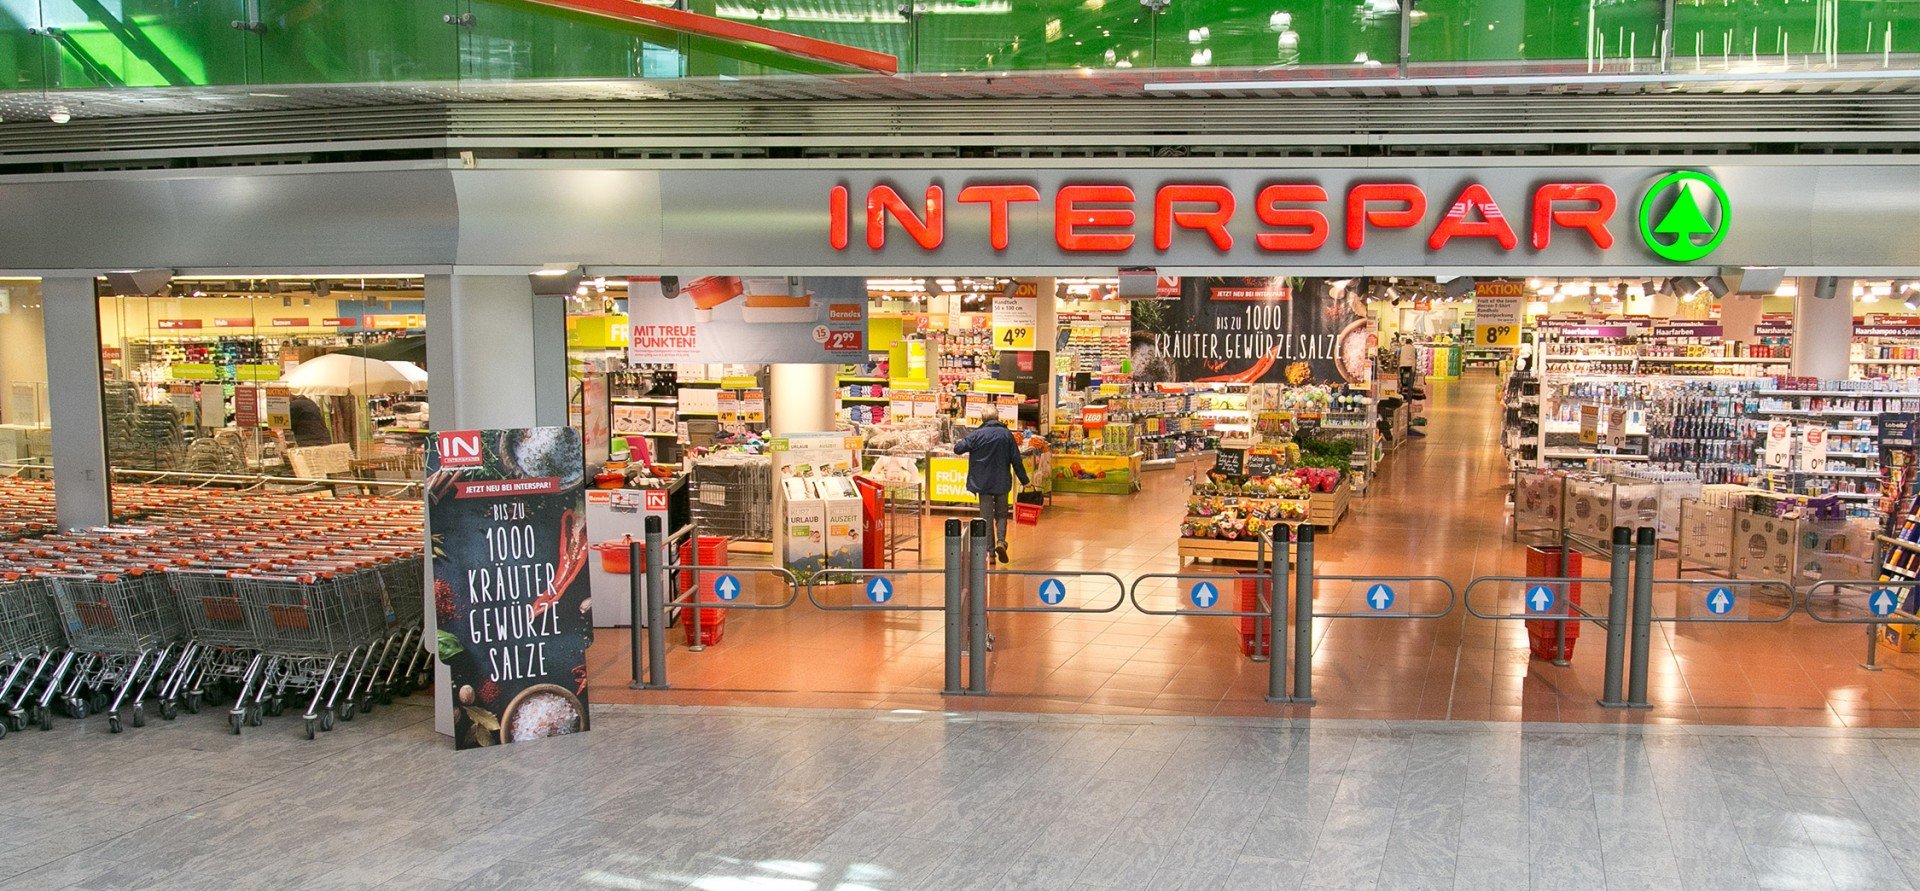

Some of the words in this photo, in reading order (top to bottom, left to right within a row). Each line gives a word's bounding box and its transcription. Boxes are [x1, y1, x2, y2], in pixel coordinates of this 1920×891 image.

[829, 183, 1618, 252] INTERSPAR
[1477, 284, 1522, 295] AKTION
[1216, 316, 1228, 330] BIS
[1230, 316, 1241, 330] ZU
[1245, 305, 1281, 330] 1000
[634, 325, 656, 336] MIT
[659, 325, 696, 336] TREUE
[1562, 328, 1600, 336] Haarfarben
[1656, 328, 1694, 336] Haarfarben
[1856, 328, 1896, 337] Haarshampoo
[634, 337, 696, 348] PUNKTEN!
[1299, 334, 1342, 359] SALZE
[1086, 413, 1100, 422] LEGO
[442, 436, 480, 458] IN
[466, 484, 484, 494] JETZT
[486, 484, 500, 492] NEU
[502, 484, 512, 492] BEI
[514, 482, 552, 491] INTERSPAR!
[648, 495, 666, 506] IN
[494, 504, 508, 521] BIS
[512, 502, 525, 520] ZU
[486, 524, 536, 562] 1000
[468, 562, 558, 604] KRÄUTER
[470, 601, 562, 644] GEWÜRZE
[489, 642, 548, 682] SALZE
